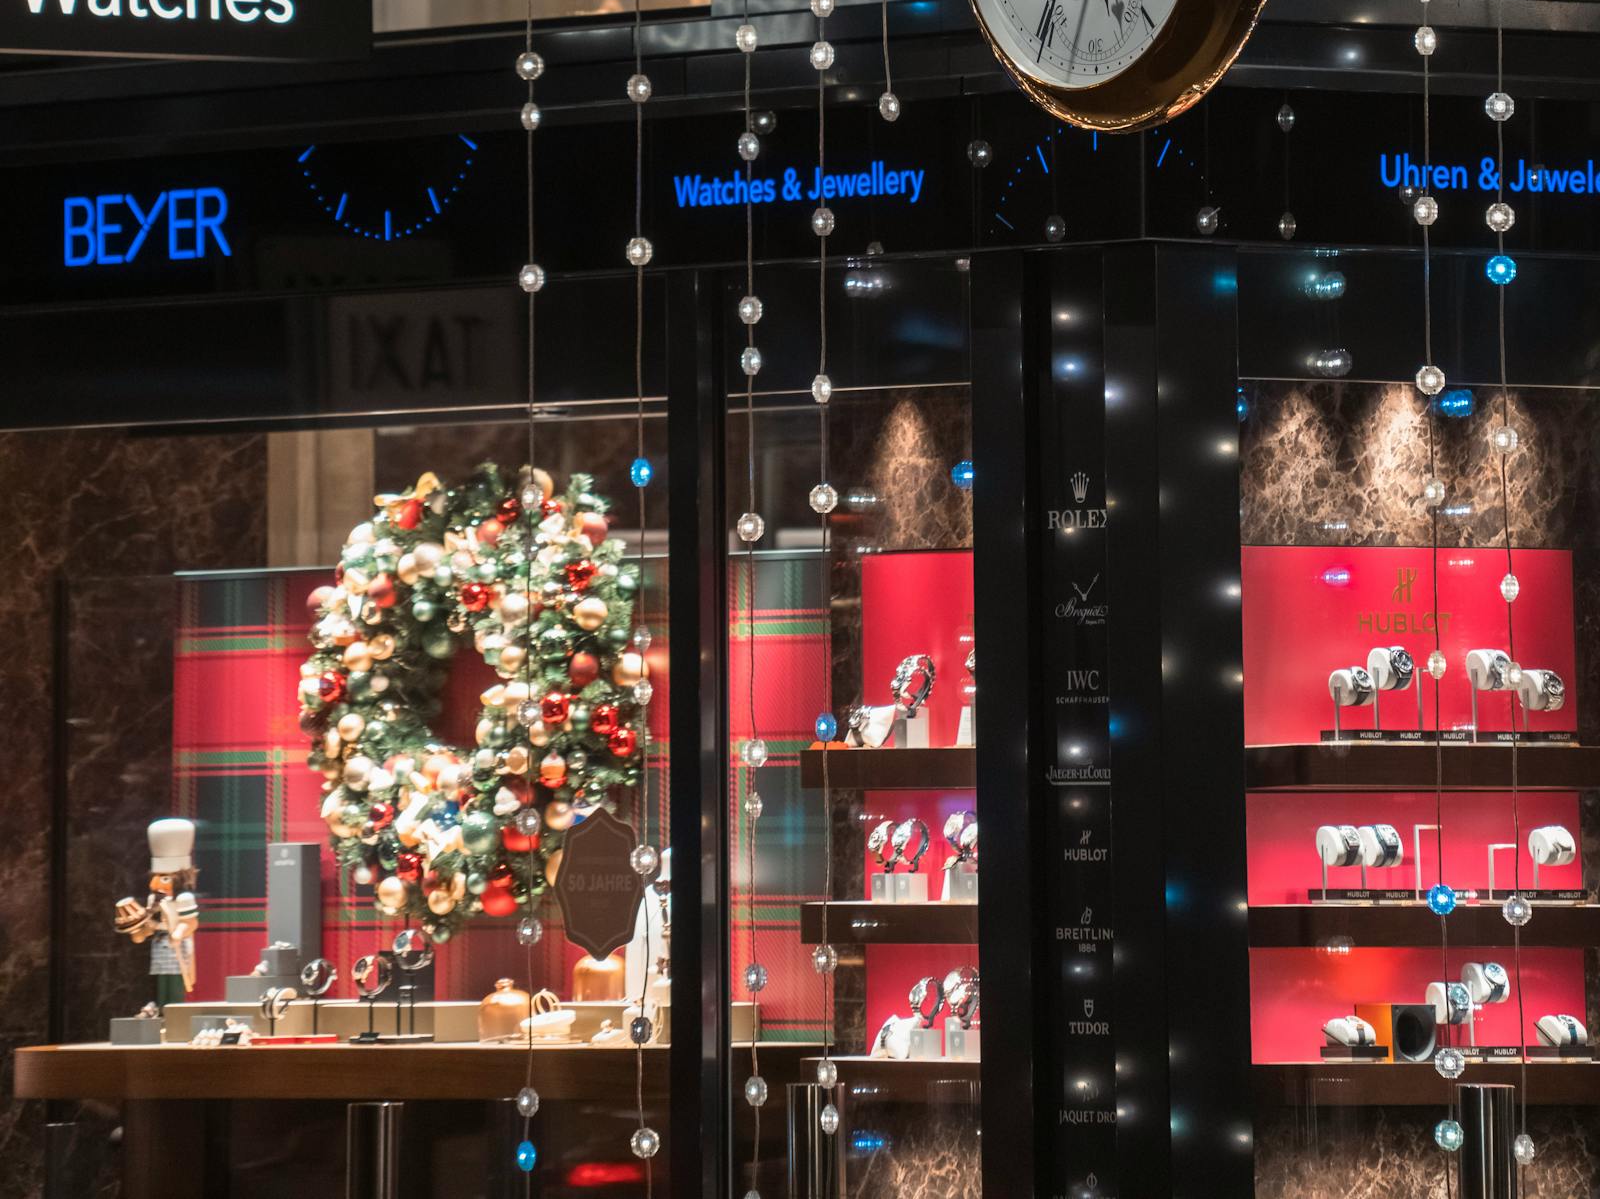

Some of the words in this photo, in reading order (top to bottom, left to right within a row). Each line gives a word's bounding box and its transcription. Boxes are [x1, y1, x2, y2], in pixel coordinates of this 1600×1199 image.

[1380, 152, 1468, 189] Uhren
[1477, 156, 1500, 191] &
[673, 170, 776, 208] Watches
[782, 167, 802, 201] &
[808, 160, 925, 205] Jewellery
[63, 187, 232, 267] BEYER
[1055, 597, 1109, 625] Breguet
[1358, 612, 1452, 635] HUBLOT
[1067, 670, 1100, 690] IWC
[1064, 848, 1108, 861] HUBLOT
[587, 873, 633, 892] JAHRE
[1079, 943, 1097, 953] 1884
[1069, 1021, 1110, 1035] TUDOR
[1059, 1110, 1095, 1126] JAQUET
